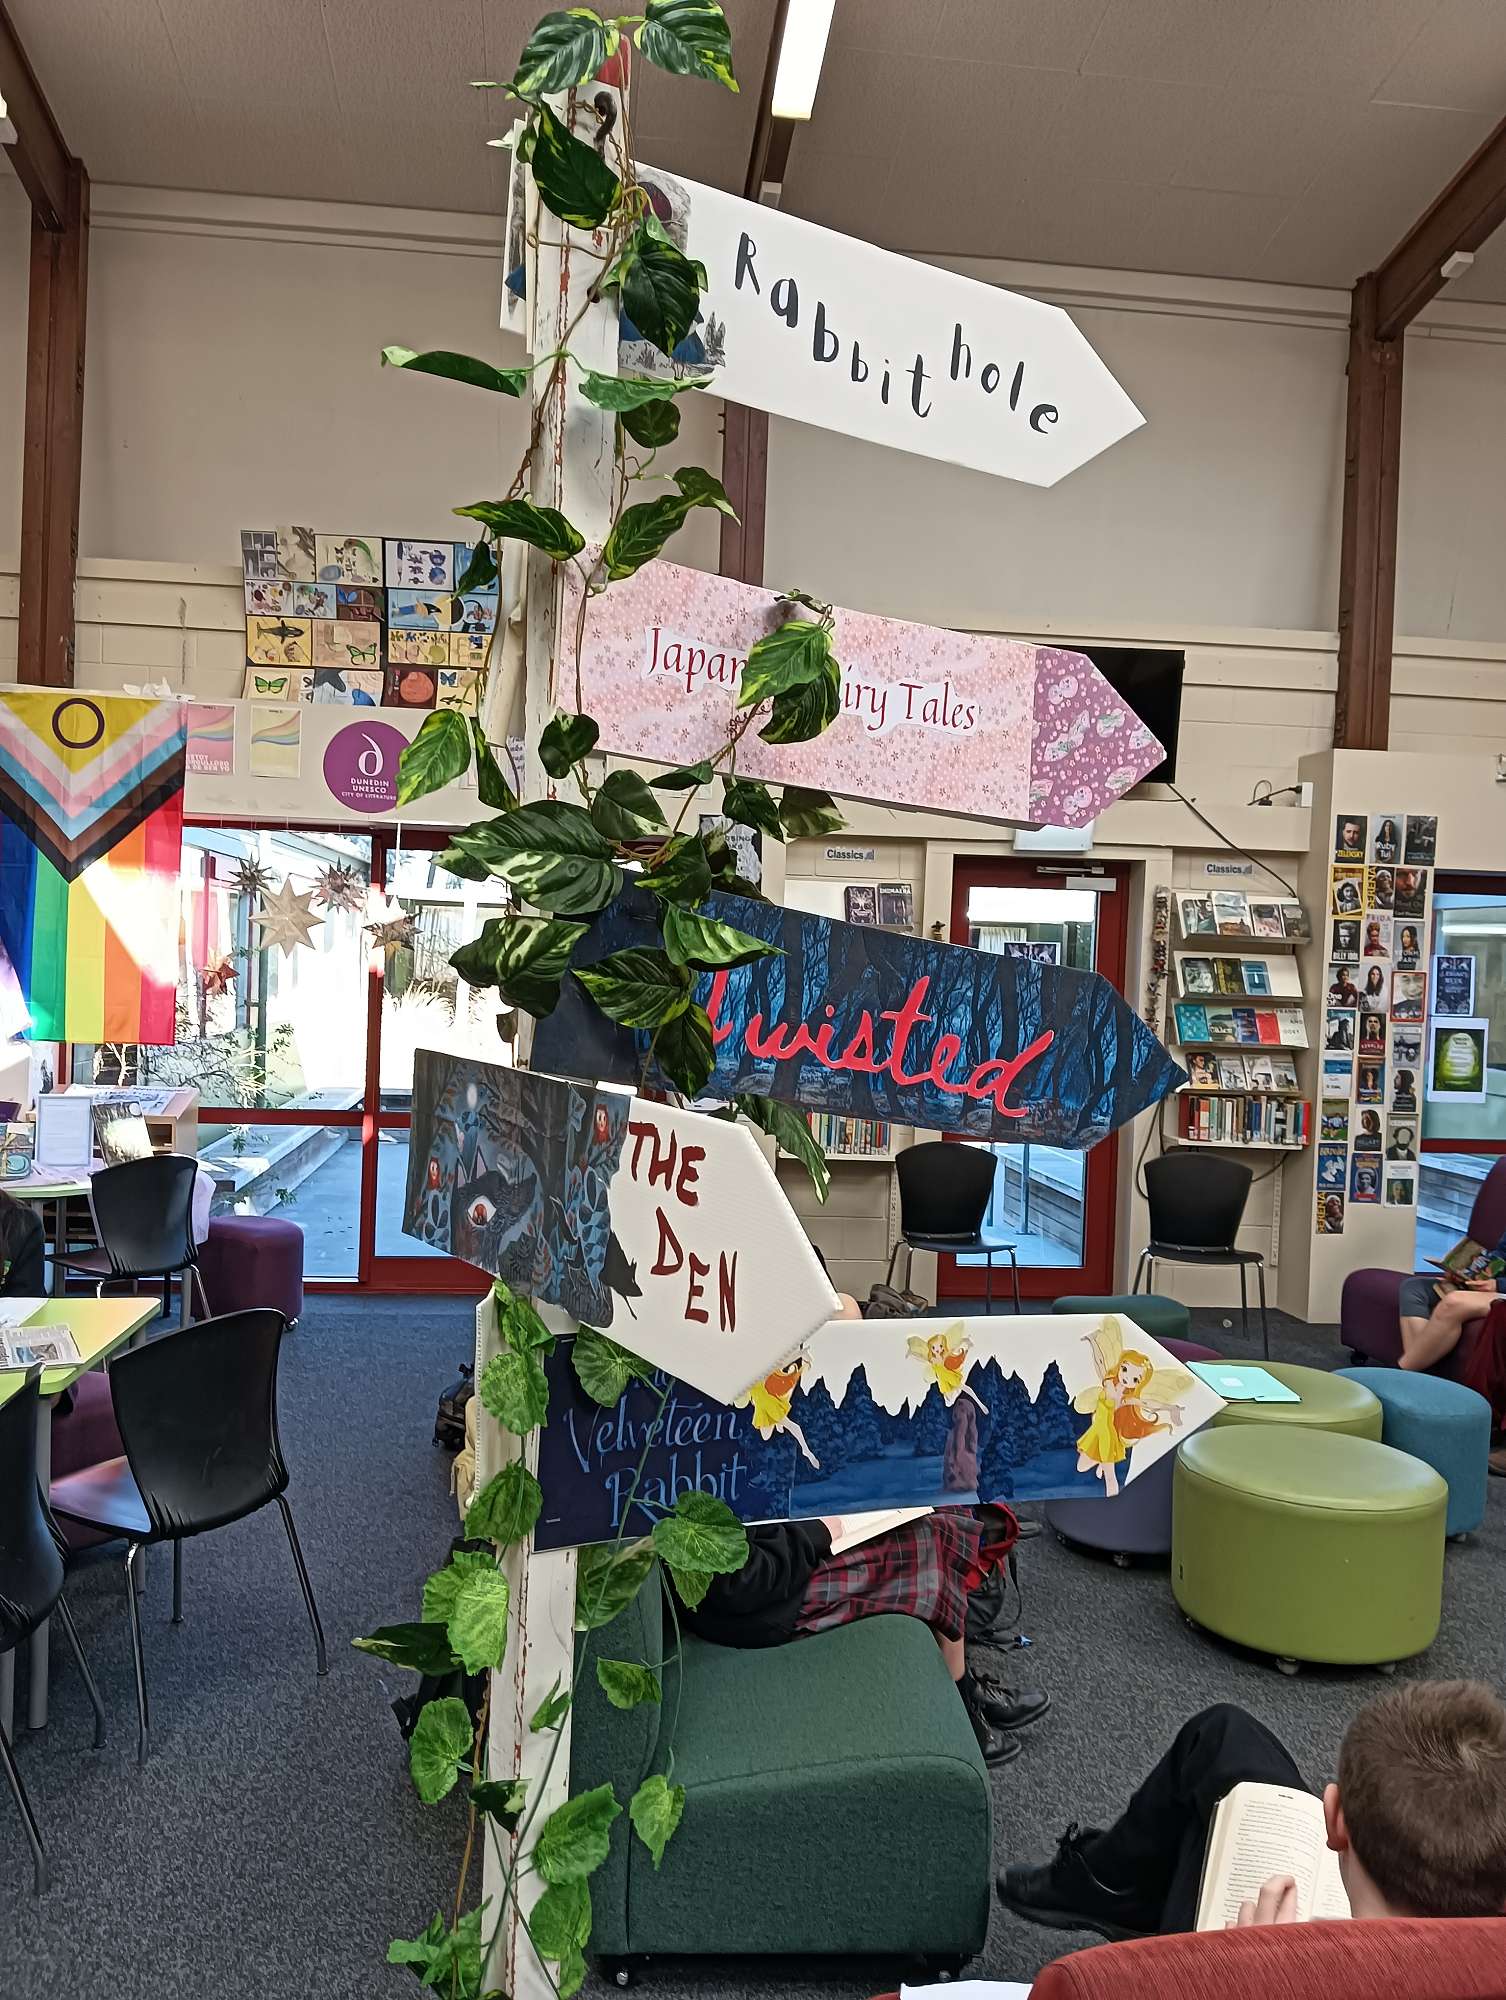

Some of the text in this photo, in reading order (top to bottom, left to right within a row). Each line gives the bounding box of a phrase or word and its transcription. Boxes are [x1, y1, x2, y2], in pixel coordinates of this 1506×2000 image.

[735, 232, 1059, 434] Rabbit hole
[649, 627, 977, 731] Japan iry Tales
[350, 777, 390, 787] DUNEDIN
[352, 785, 387, 794] UNESCO
[826, 849, 864, 860] Classics
[1206, 863, 1242, 874] Classics
[628, 1121, 707, 1207] THE
[650, 1206, 738, 1333] DEN
[562, 1394, 743, 1473] Velveteen
[605, 1450, 748, 1527] Rabbit
